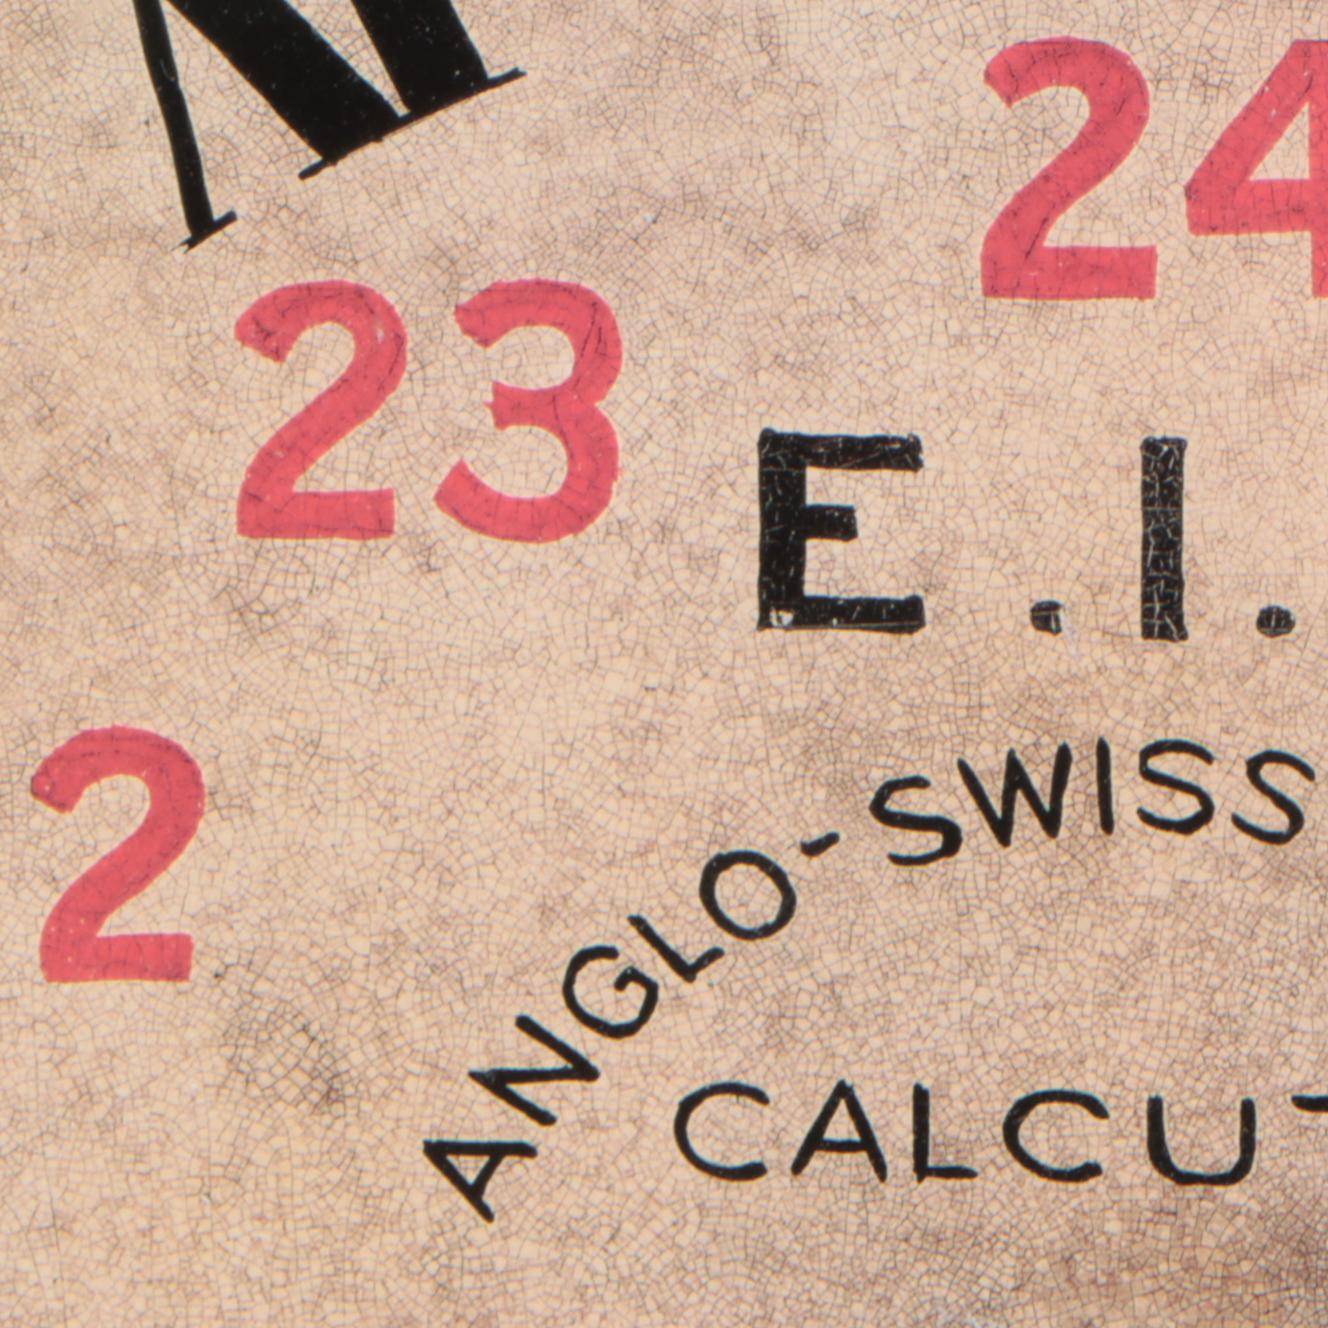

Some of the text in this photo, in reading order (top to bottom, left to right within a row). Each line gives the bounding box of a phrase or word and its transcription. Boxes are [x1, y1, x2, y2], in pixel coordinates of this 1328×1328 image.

[235, 278, 623, 543] 23
[31, 724, 206, 983] 2
[422, 736, 1316, 1223] ANGLO-SWISS
